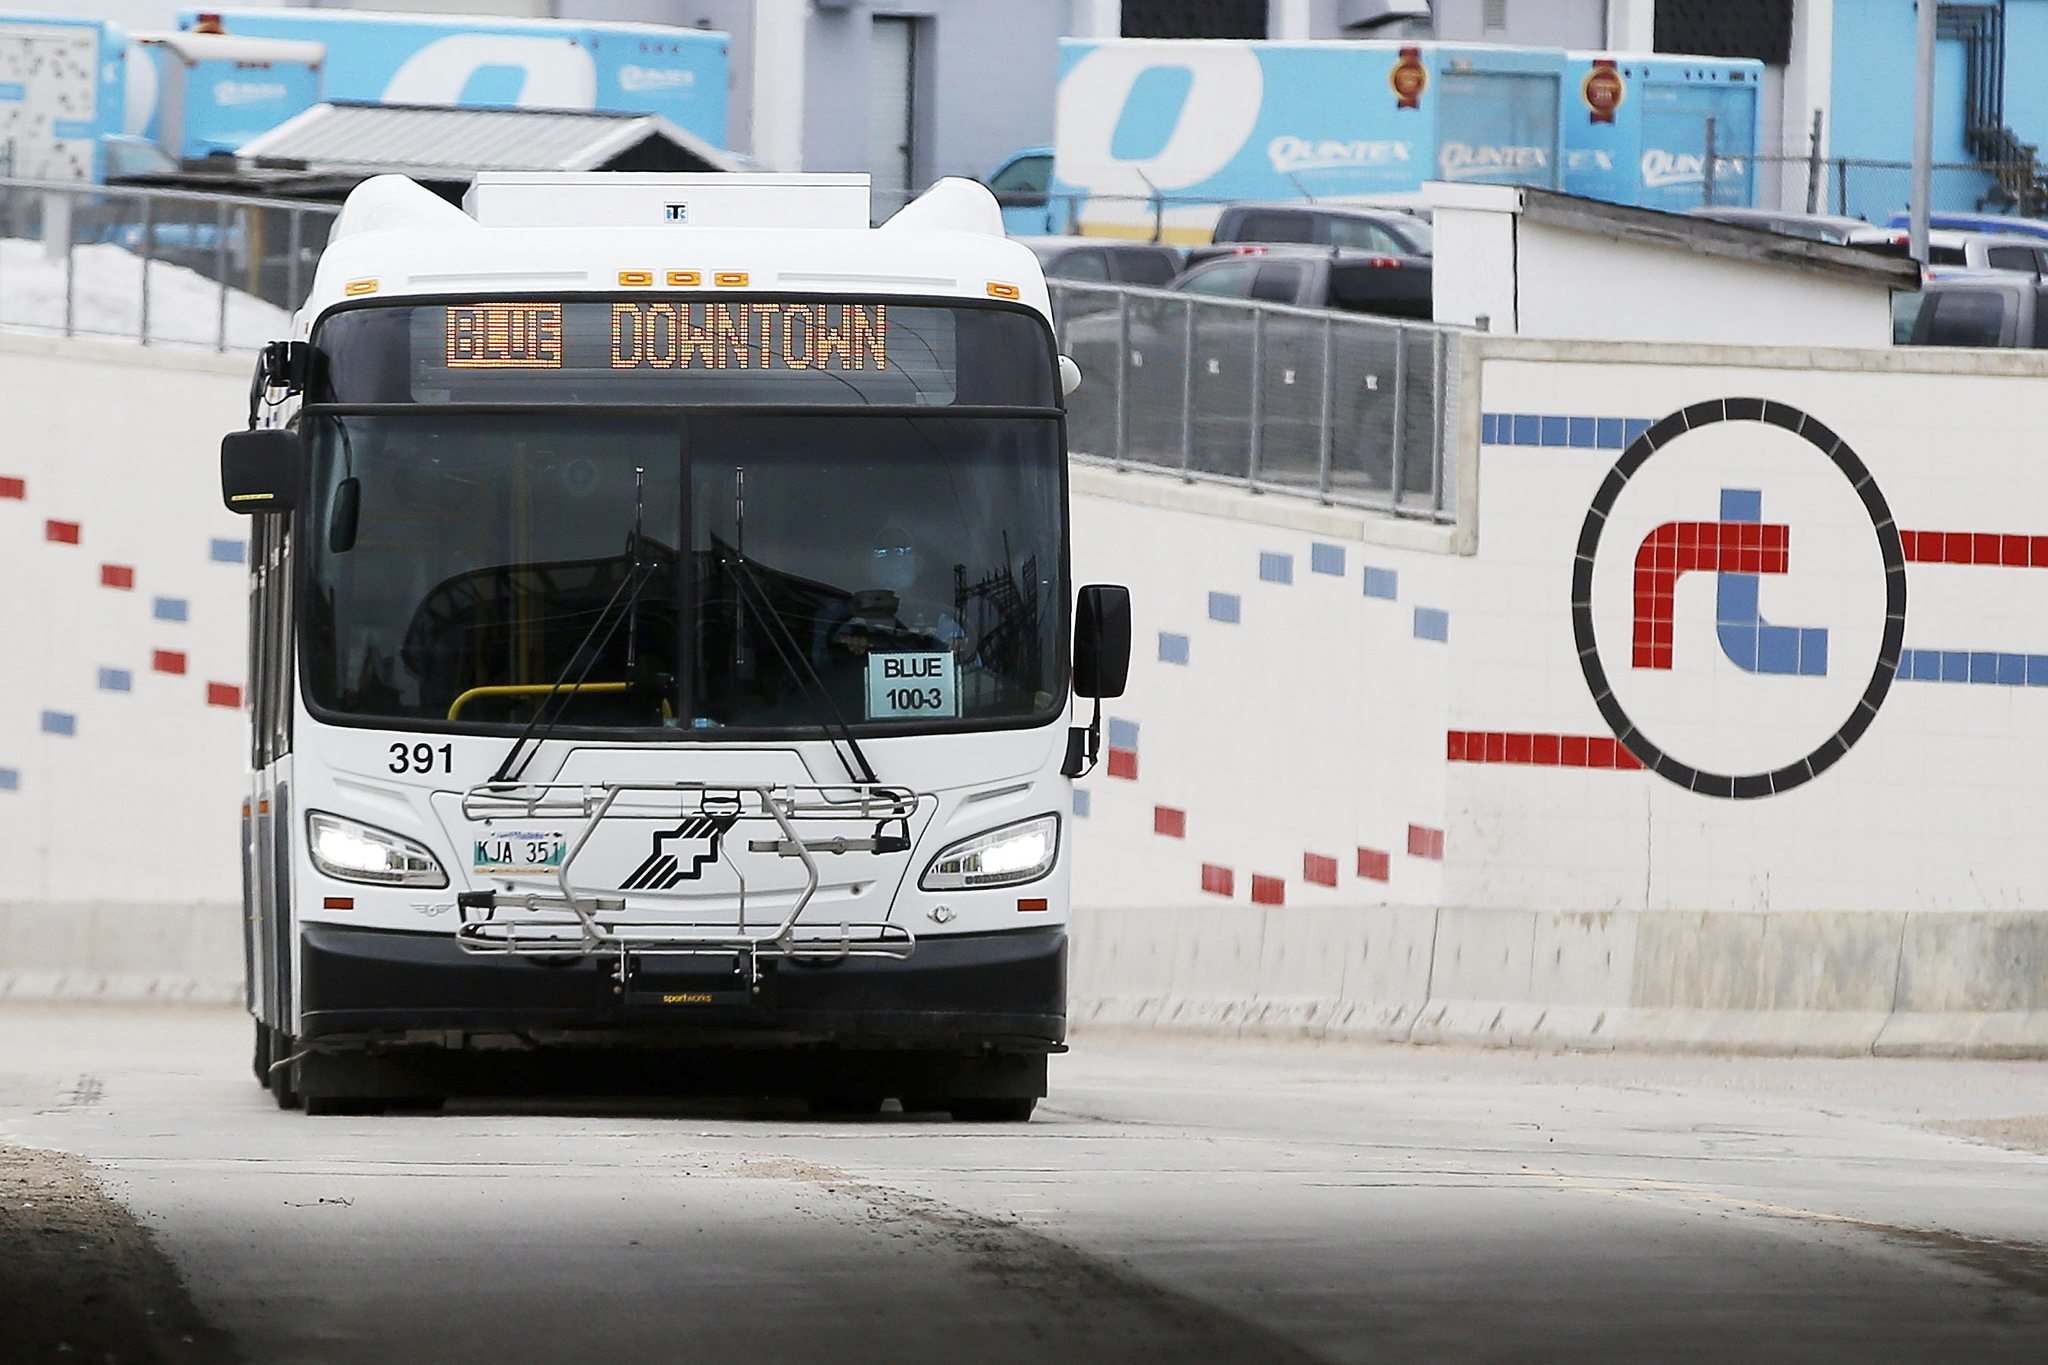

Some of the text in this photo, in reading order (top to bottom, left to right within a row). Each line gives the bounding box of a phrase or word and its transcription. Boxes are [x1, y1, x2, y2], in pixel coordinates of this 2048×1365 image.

[1642, 149, 1745, 187] QUINEX
[448, 303, 886, 369] BLUE DOWNTOWN
[884, 658, 942, 678] BLUE
[886, 688, 942, 709] 100-3
[389, 743, 452, 773] 391
[478, 841, 559, 863] KJA 351
